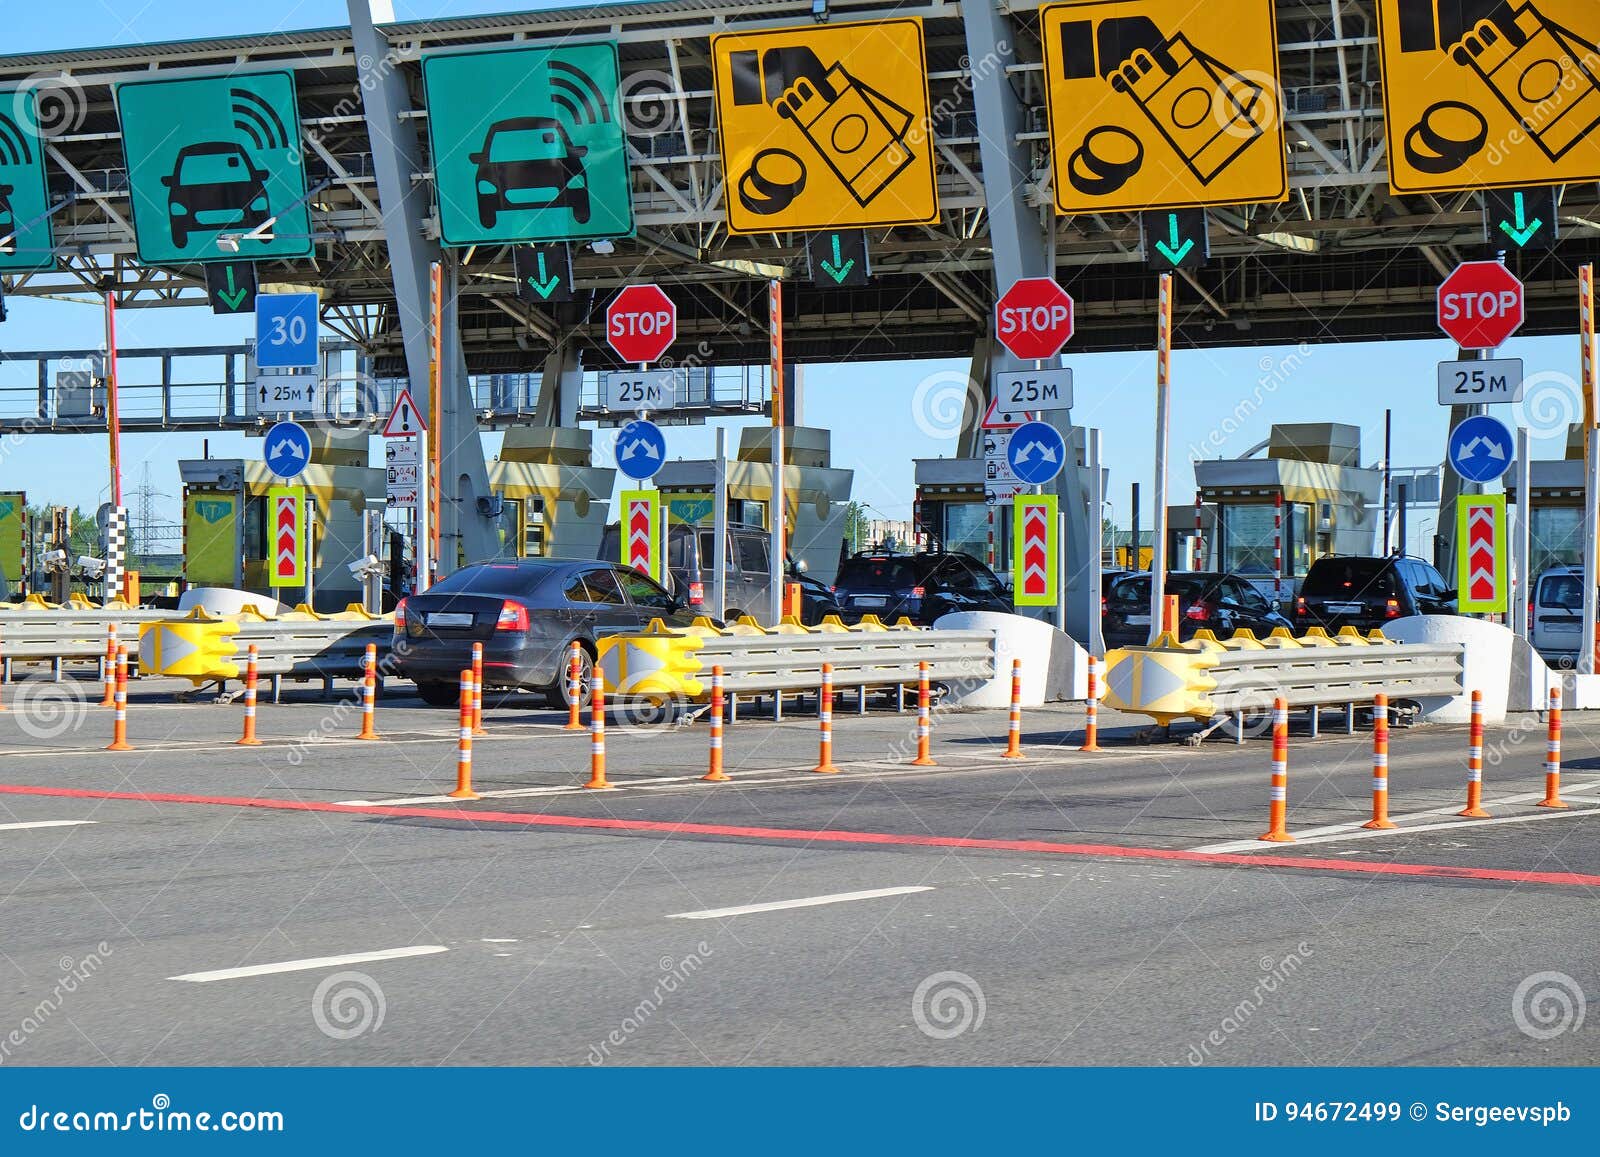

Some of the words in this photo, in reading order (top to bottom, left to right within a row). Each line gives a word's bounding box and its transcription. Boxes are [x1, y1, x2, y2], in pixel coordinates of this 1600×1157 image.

[1001, 305, 1068, 333] STOP
[1443, 291, 1518, 320] STOP
[271, 315, 306, 345] 30
[611, 311, 671, 337] STOP
